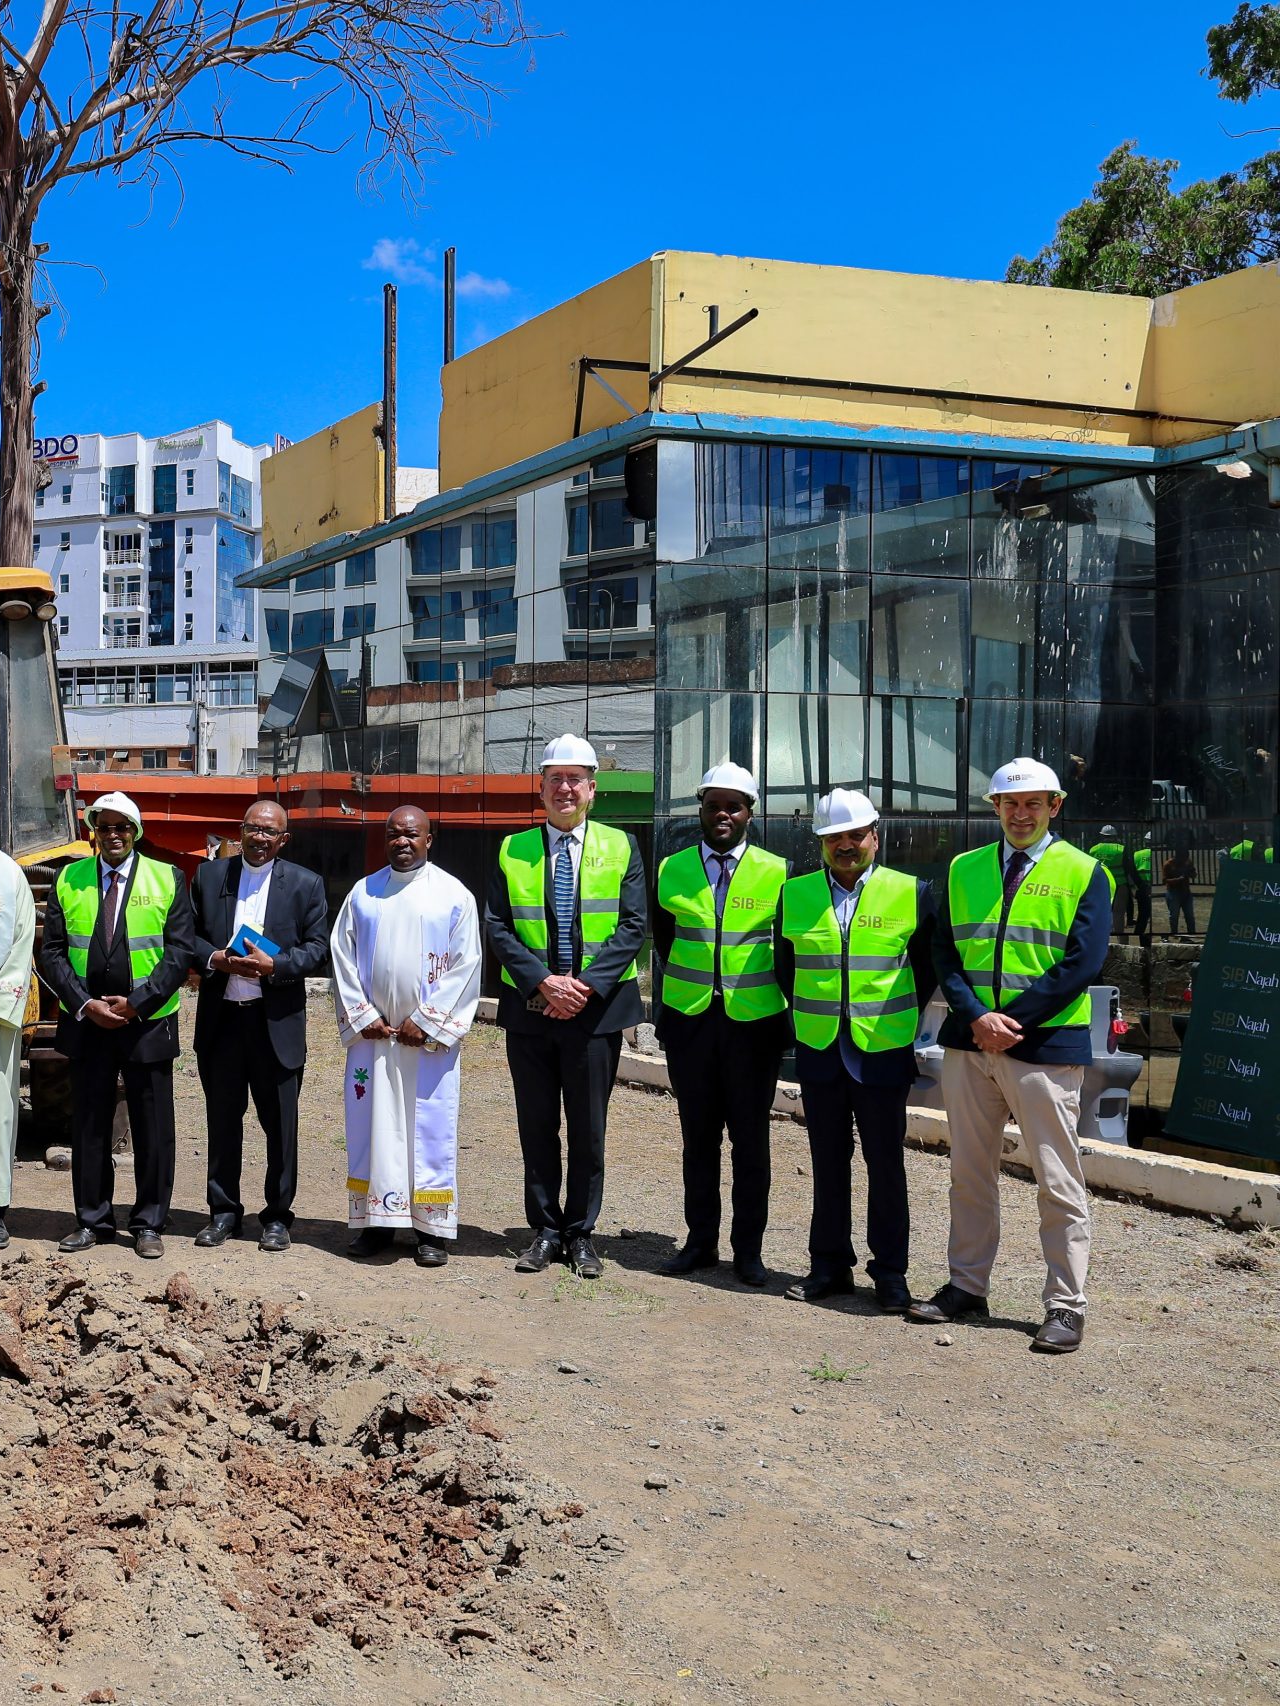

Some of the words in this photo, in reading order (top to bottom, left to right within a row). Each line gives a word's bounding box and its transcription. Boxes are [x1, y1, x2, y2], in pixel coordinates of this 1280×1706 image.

[32, 434, 78, 458] BDO
[1007, 774, 1021, 783] SIB
[1023, 883, 1051, 897] SIB
[1238, 879, 1263, 895] SIB
[131, 895, 151, 907] SIB
[732, 896, 755, 910] SIB
[857, 915, 883, 929] SIB
[1229, 923, 1254, 939] SIB
[1221, 966, 1245, 982] SIB
[1245, 969, 1279, 989] Najah
[1211, 1010, 1236, 1027] SIB
[1236, 1014, 1270, 1034] Najah
[1202, 1052, 1227, 1070] SIB
[1227, 1057, 1261, 1077] Najah
[1217, 1102, 1252, 1122] Najah
